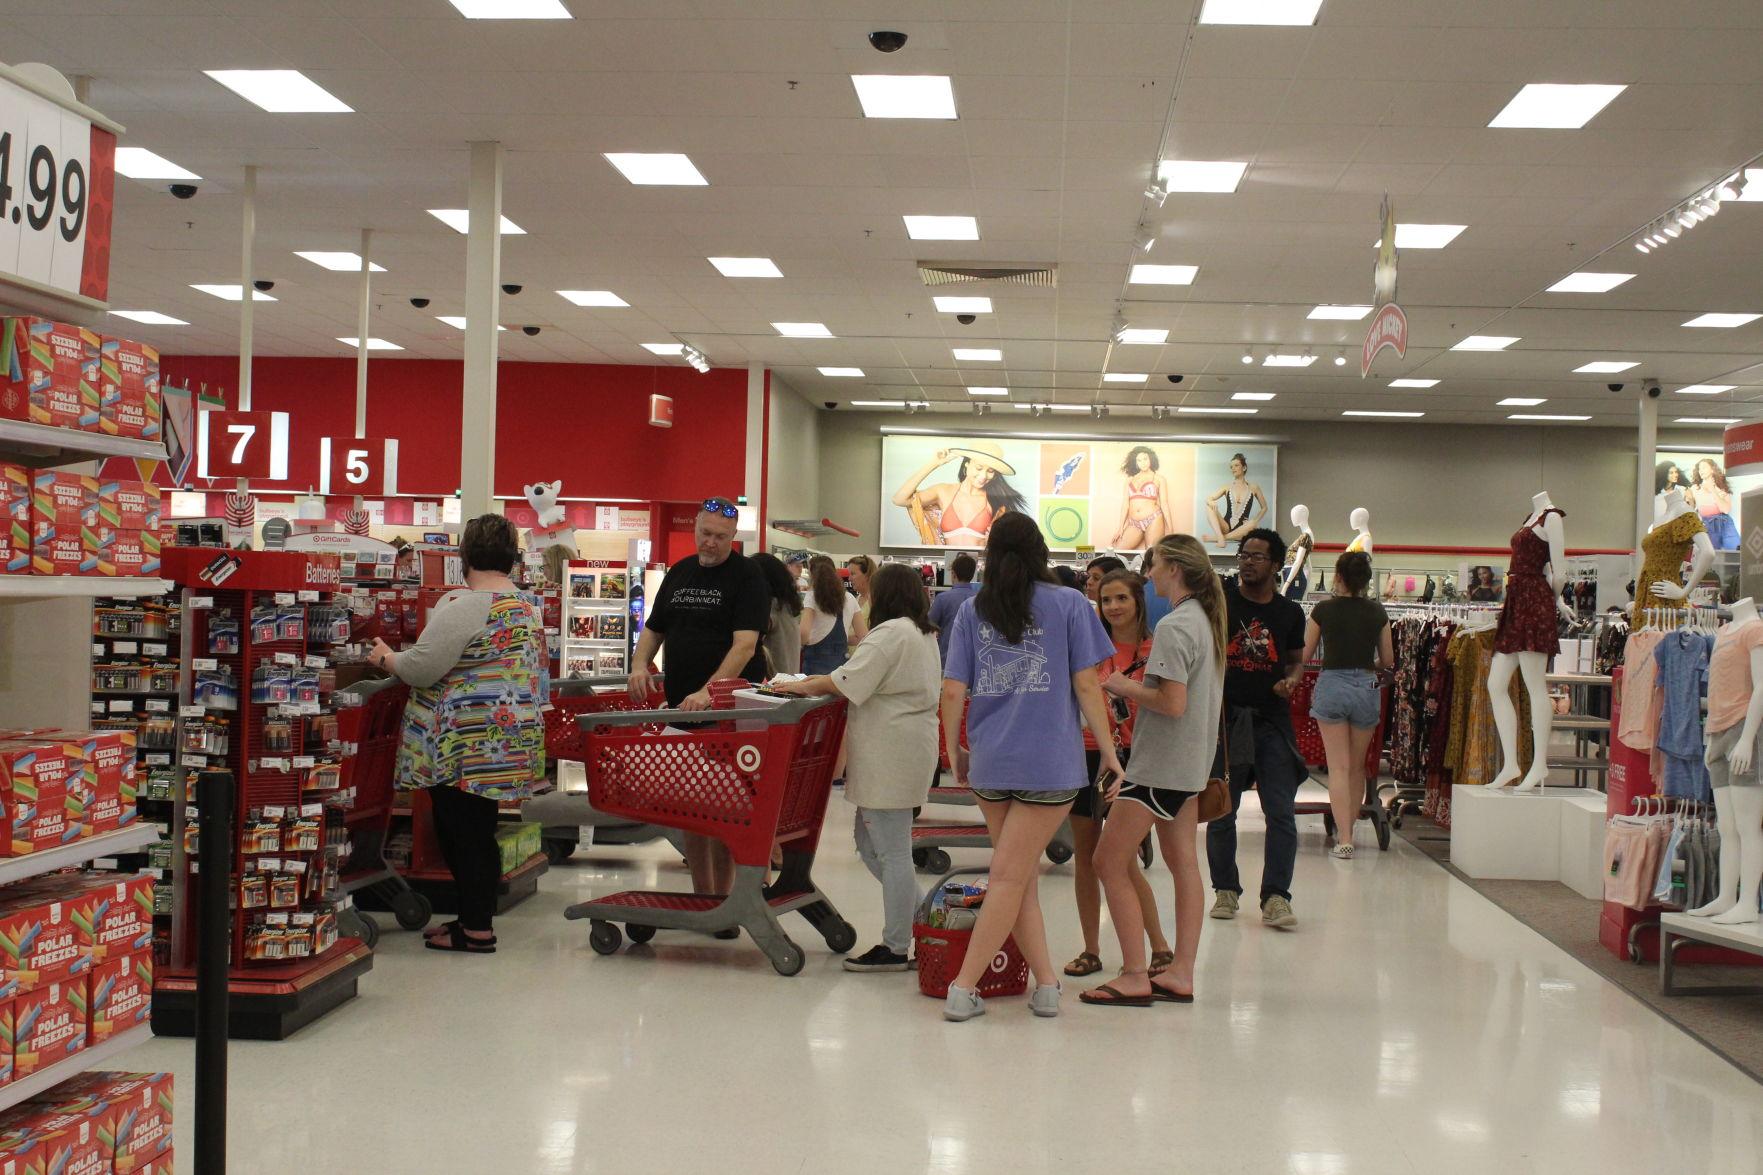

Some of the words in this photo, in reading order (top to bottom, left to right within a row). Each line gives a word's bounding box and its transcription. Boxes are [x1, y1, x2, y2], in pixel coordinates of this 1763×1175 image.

[54, 391, 78, 404] POLAR
[122, 404, 143, 416] POLAR
[227, 425, 256, 464] 7
[346, 450, 370, 484] 5
[57, 541, 80, 552] POLAR
[118, 544, 140, 555] POLAR
[306, 560, 341, 584] Batteries
[587, 560, 610, 568] new
[97, 799, 118, 811] POLAR
[38, 815, 63, 827] POLAR
[105, 912, 136, 931] POLAR
[38, 934, 73, 955] POLAR
[100, 922, 141, 945] FREEZES
[31, 945, 79, 969] FREEZES
[112, 985, 138, 1005] POLAR
[107, 997, 141, 1019] FREEZES
[38, 1013, 69, 1035] POLAR
[31, 1024, 74, 1050] FREEZES
[133, 1116, 160, 1138] POLAR
[129, 1125, 163, 1153] FREEZES
[68, 1151, 98, 1174] POLAR
